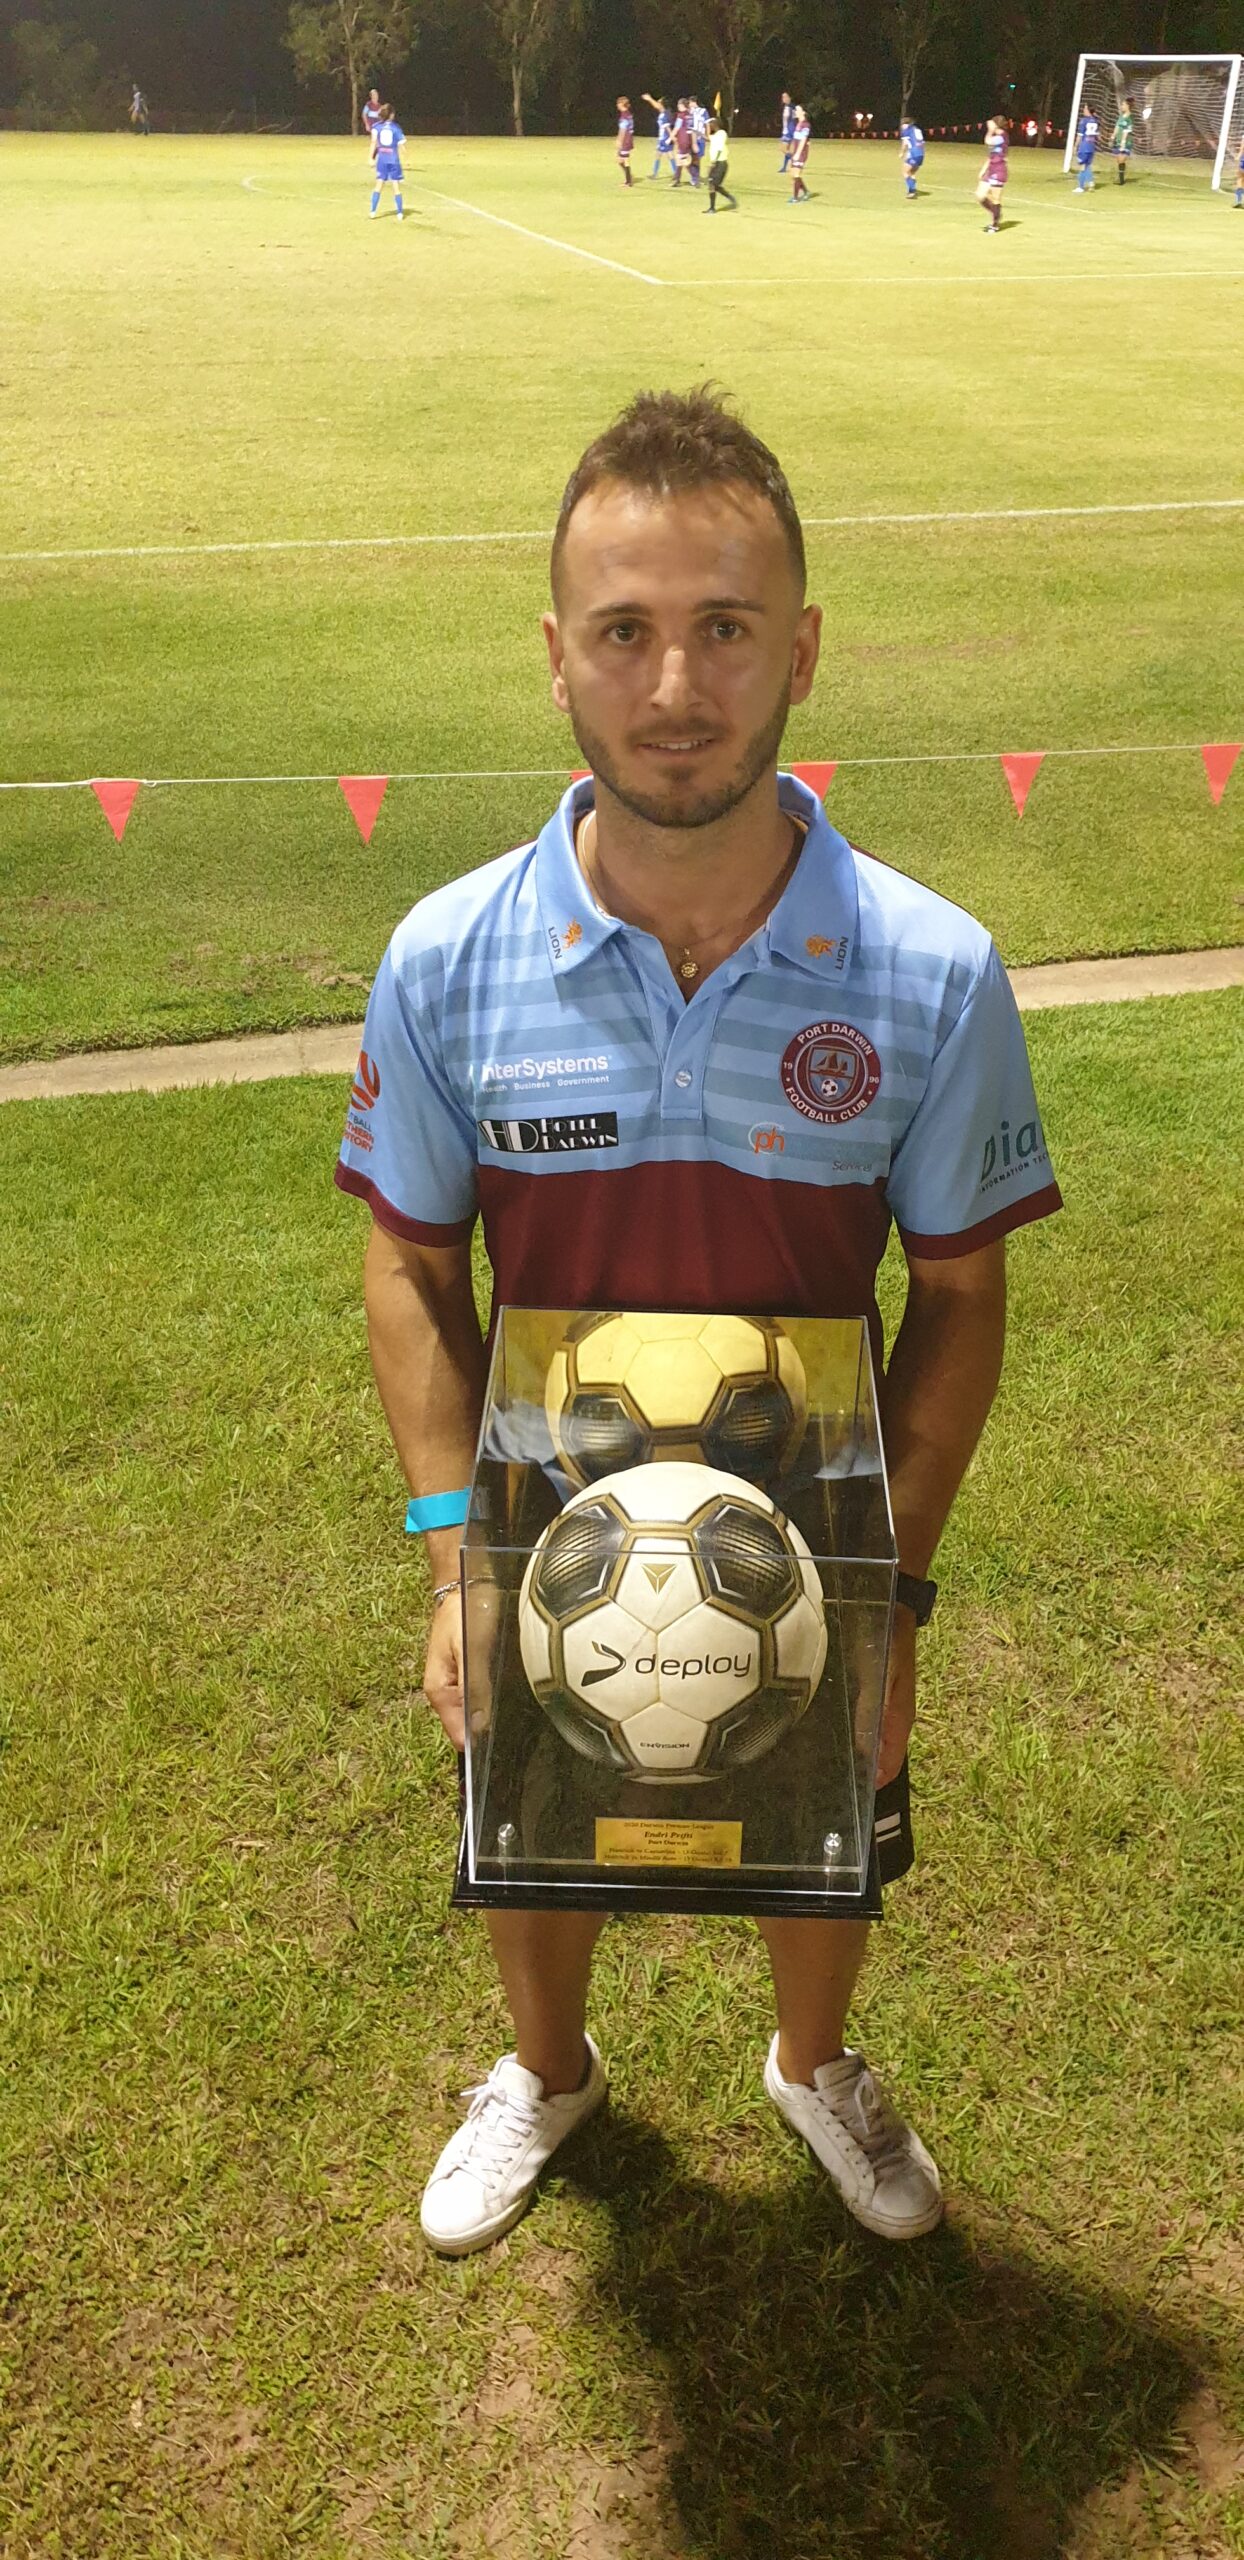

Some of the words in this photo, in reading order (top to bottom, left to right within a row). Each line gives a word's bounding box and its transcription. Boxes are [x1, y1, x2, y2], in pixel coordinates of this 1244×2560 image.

[548, 926, 563, 959] LION
[835, 936, 849, 970] LION
[796, 1023, 829, 1045] PORT
[831, 1023, 874, 1056] DARWIN
[481, 1054, 609, 1083] InterSystems
[783, 1061, 793, 1070] 19
[514, 1080, 551, 1091] Business
[557, 1074, 610, 1088] Government
[785, 1087, 838, 1123] FOOTBALL
[840, 1099, 868, 1121] CLUB
[479, 1120, 539, 1152] HD
[540, 1117, 600, 1134] HOTEL
[540, 1134, 618, 1150] DARWIN
[635, 1652, 752, 1680] deploy
